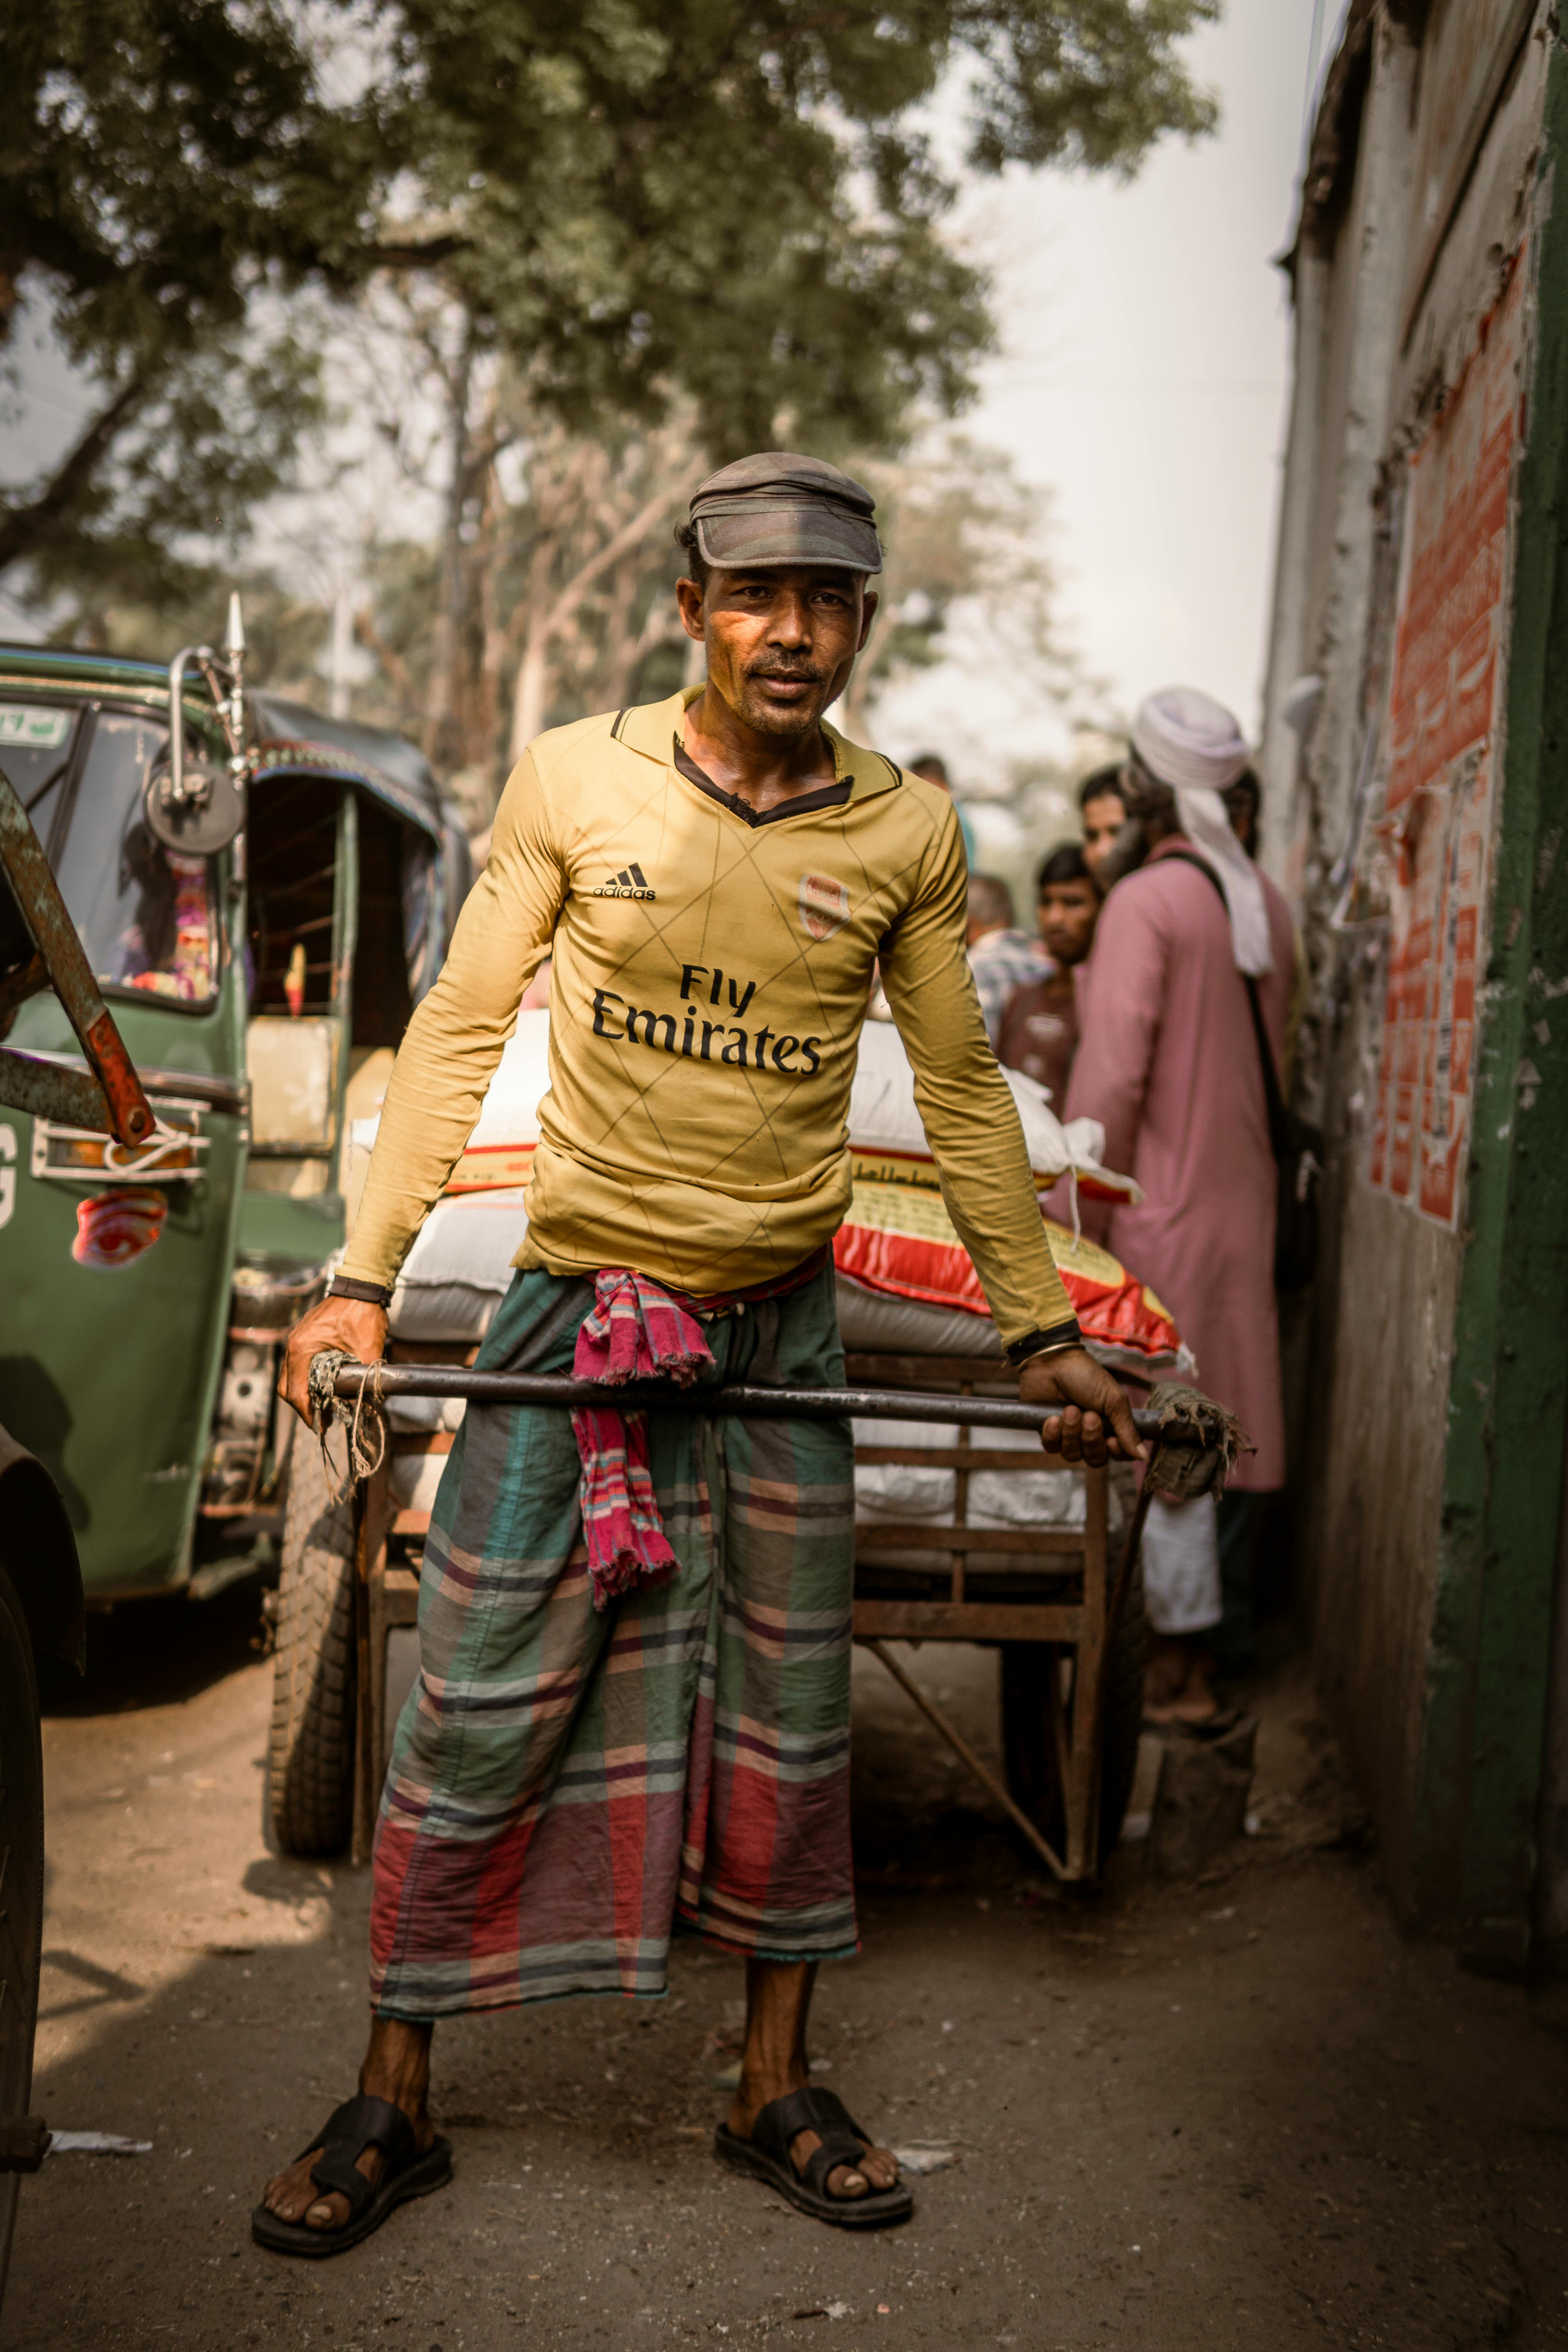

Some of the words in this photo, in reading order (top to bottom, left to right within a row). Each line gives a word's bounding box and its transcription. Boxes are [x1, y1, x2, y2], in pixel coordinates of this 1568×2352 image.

[593, 887, 656, 900] adidas
[680, 964, 756, 1018] Fly
[592, 987, 822, 1075] Emirates
